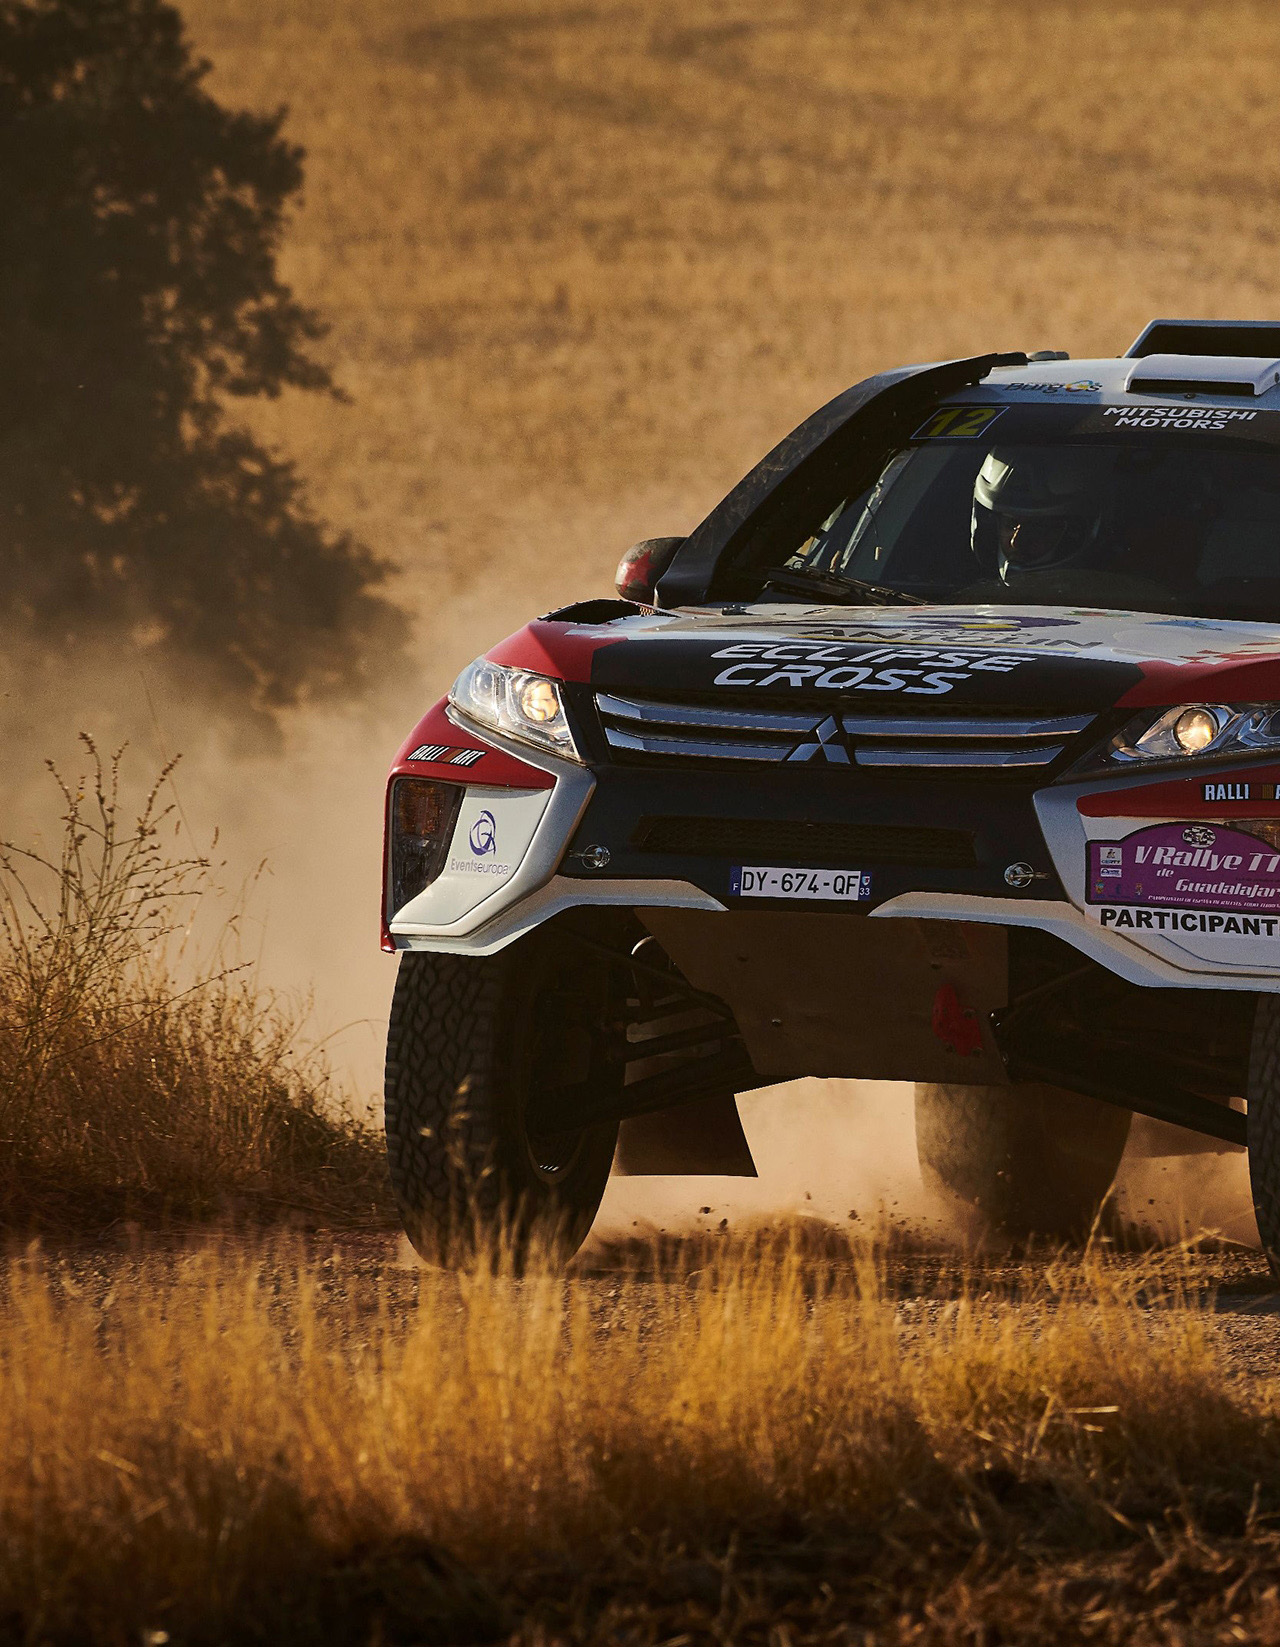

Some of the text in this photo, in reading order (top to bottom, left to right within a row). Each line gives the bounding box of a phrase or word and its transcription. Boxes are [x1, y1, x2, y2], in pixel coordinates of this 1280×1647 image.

[927, 408, 996, 436] 12
[1103, 407, 1258, 420] MITSUBISHI
[1114, 417, 1229, 430] MOTORS
[798, 629, 1103, 648] ANTOLIN
[710, 643, 1038, 672] ECLIPSE
[712, 663, 973, 695] CROSS
[451, 858, 509, 875] Eventseuropa
[1134, 846, 1153, 864] V
[1151, 846, 1243, 872] Rallye
[1156, 868, 1174, 877] de
[733, 872, 871, 896] F DY-674-QF 33
